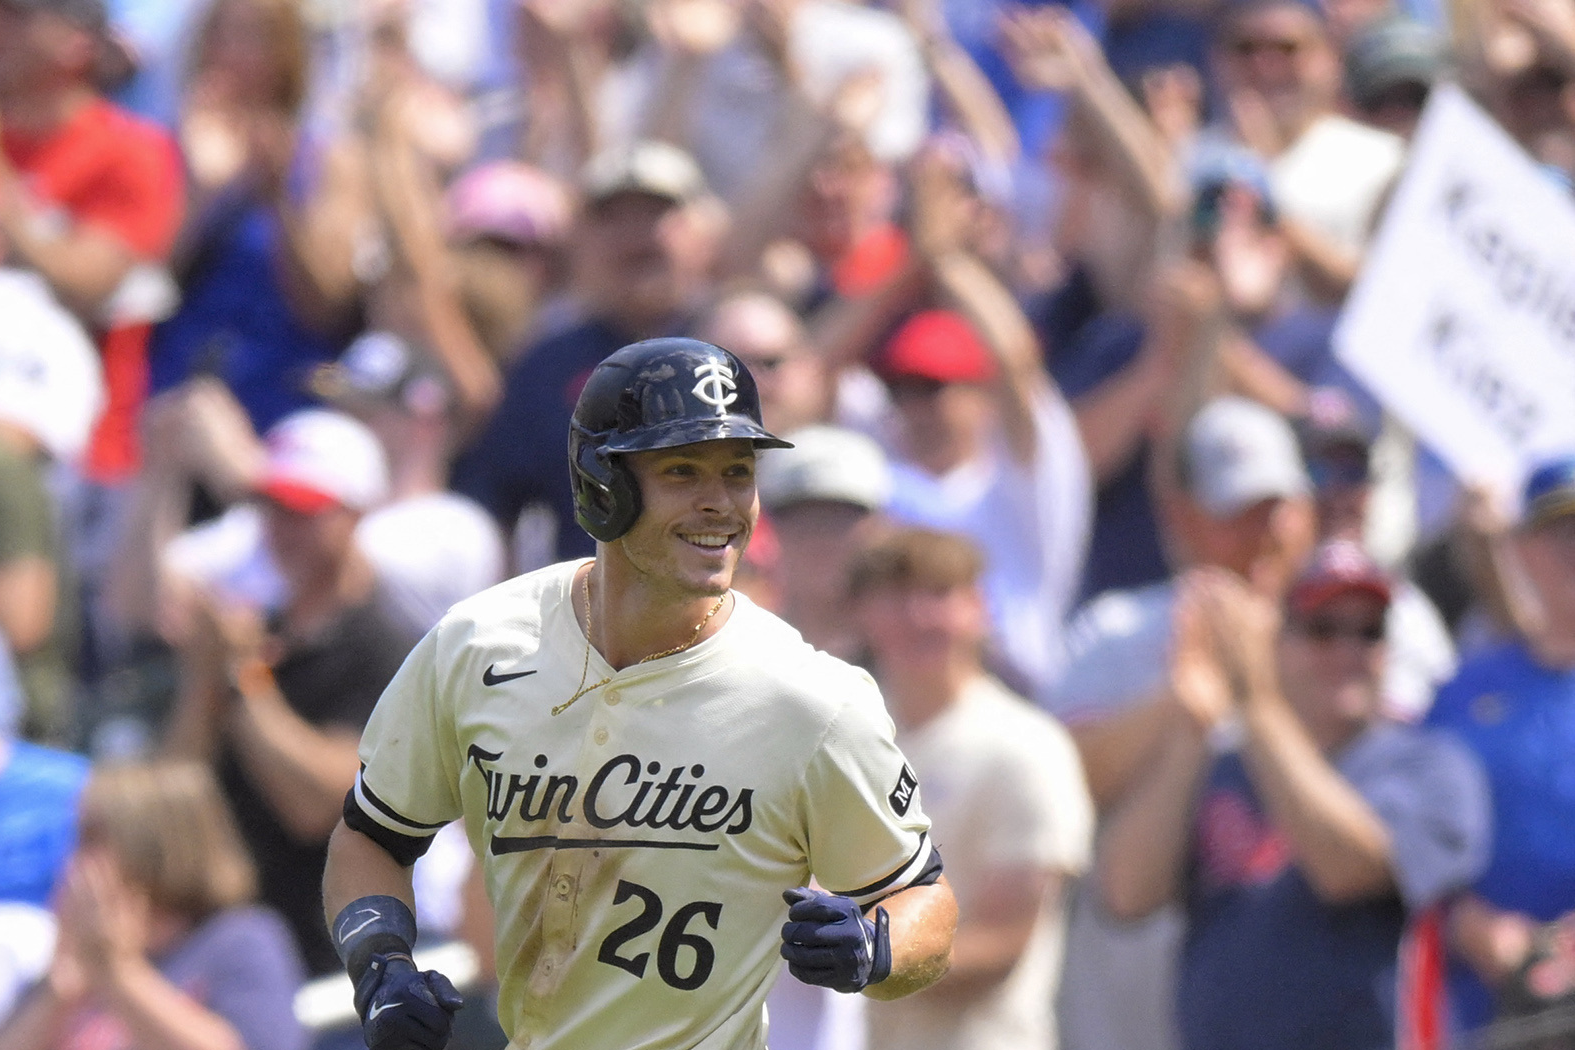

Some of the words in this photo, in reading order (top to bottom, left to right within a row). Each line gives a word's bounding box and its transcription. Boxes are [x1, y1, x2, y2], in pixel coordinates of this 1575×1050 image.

[467, 744, 577, 824] Twin
[582, 754, 754, 835] Cities
[597, 879, 723, 991] 26
